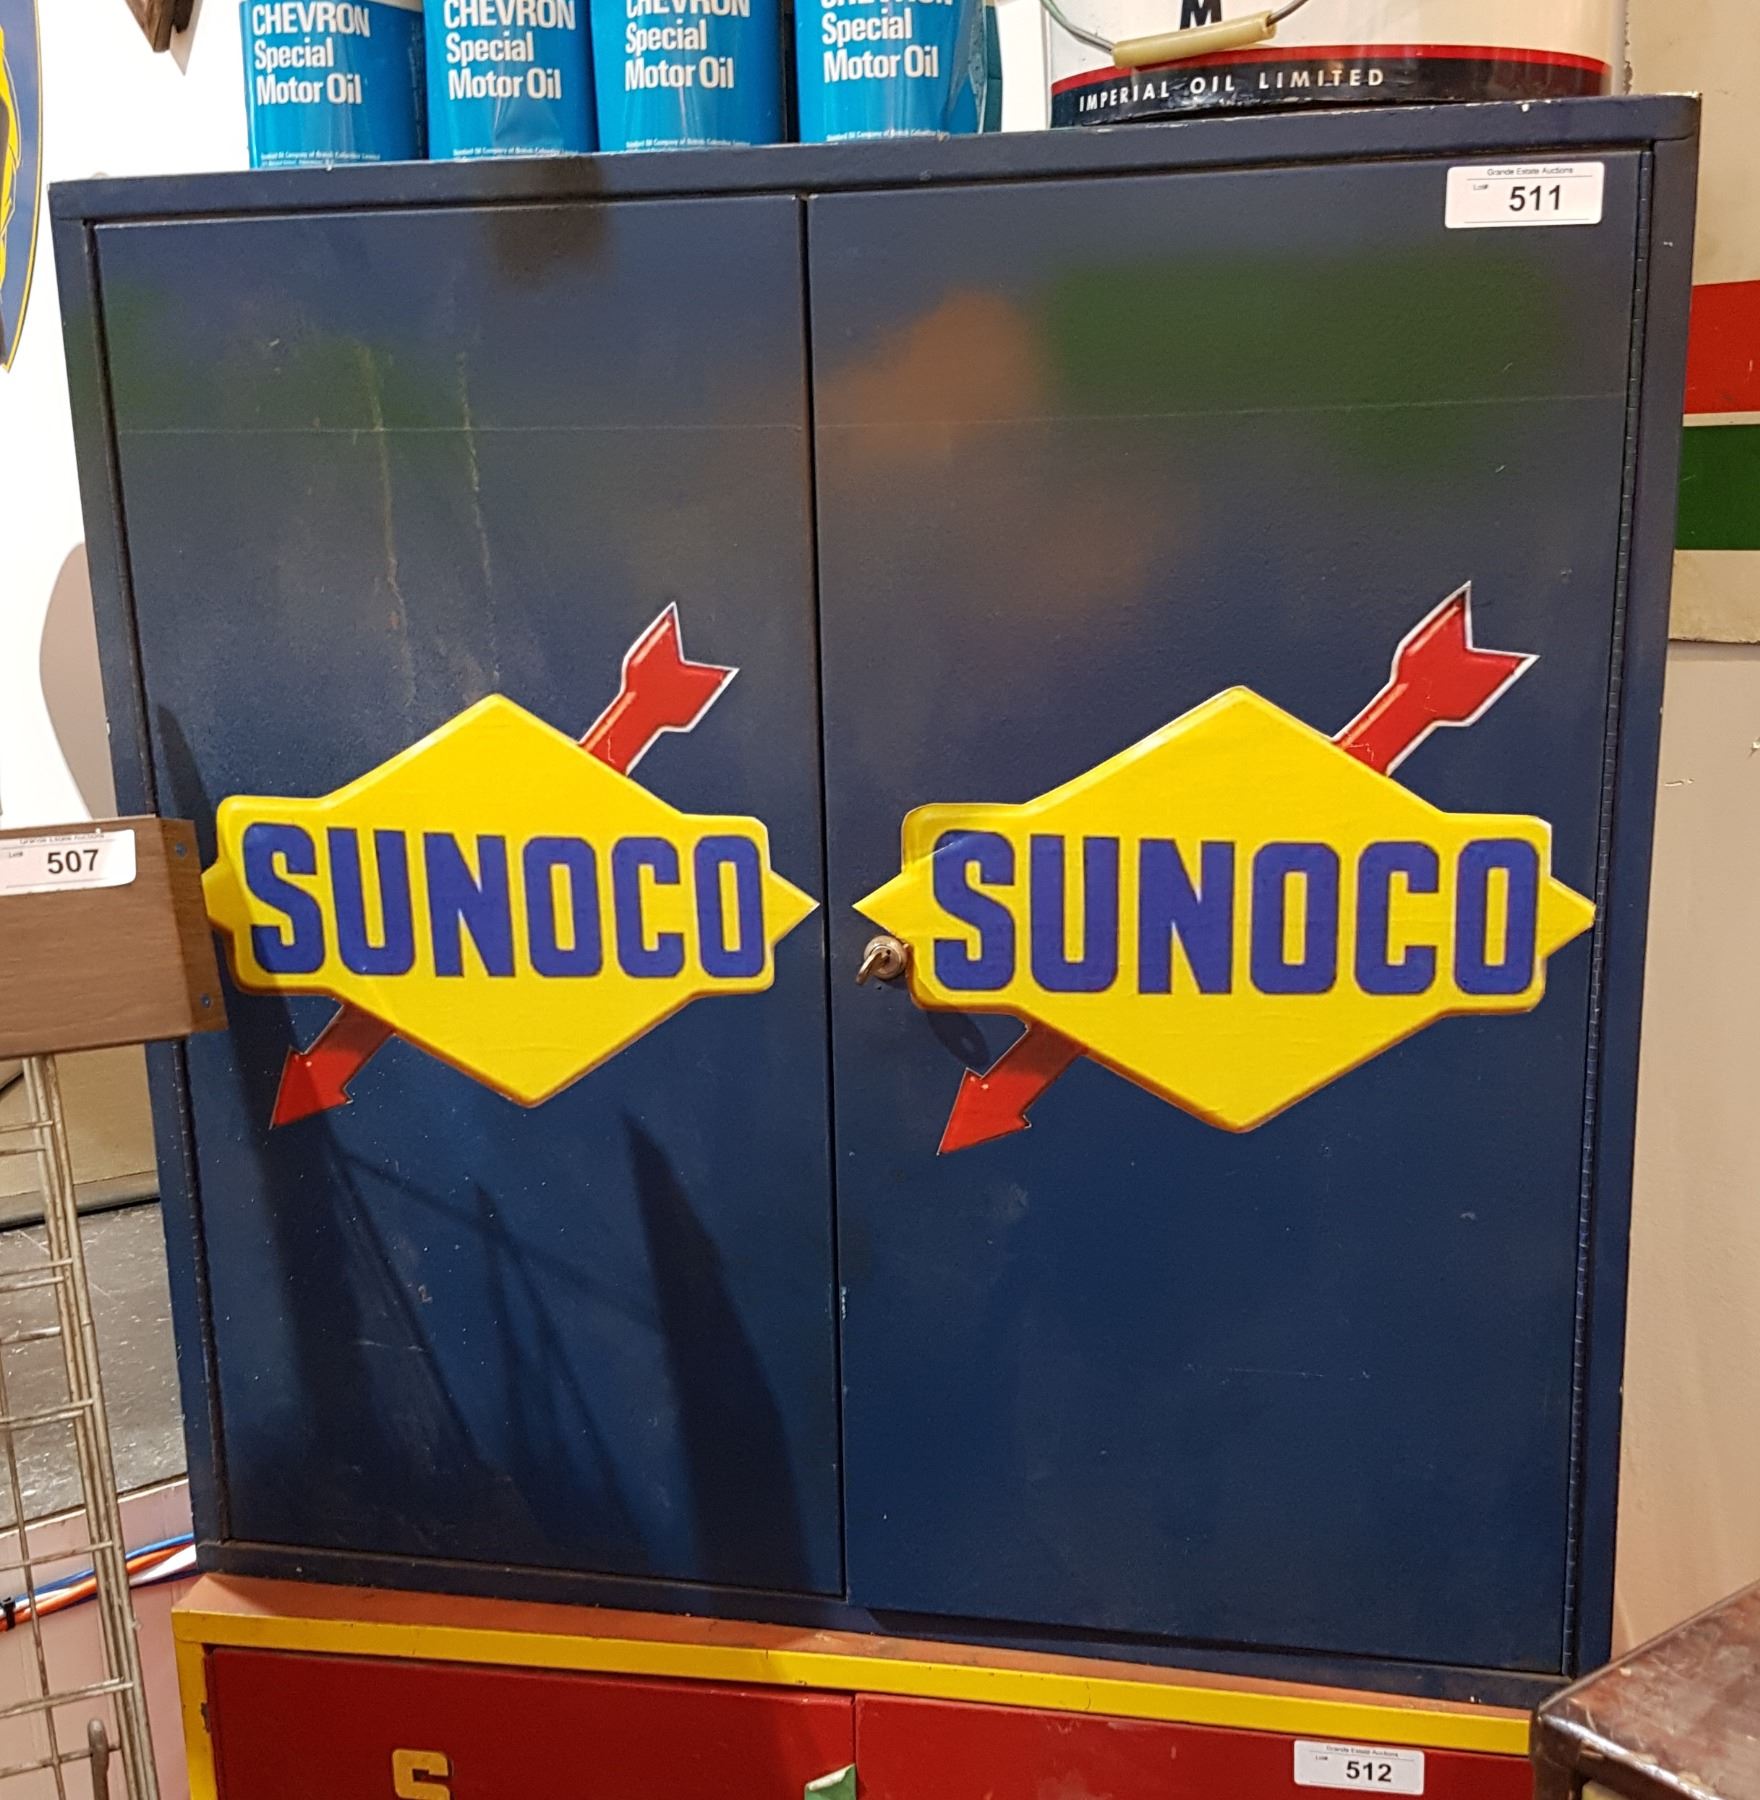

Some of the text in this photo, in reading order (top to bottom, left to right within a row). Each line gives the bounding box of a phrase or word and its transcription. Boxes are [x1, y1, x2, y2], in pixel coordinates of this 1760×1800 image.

[252, 1, 370, 37] CHEVRON
[443, 0, 576, 30] CHEVRON
[821, 8, 912, 47] Special
[446, 31, 534, 67] Special
[625, 19, 707, 56] Special
[254, 38, 333, 74] Special
[625, 56, 734, 91] Motor Oil
[823, 45, 939, 83] Motor Oil
[256, 74, 362, 105] Motor Oil
[449, 68, 561, 100] Motor Oil
[1079, 69, 1384, 112] IMPERIAL OIL LIMITED
[1487, 168, 1514, 176] Grande
[1509, 185, 1560, 212] 511
[47, 849, 98, 874] 507
[242, 822, 765, 978] SUNOCO
[932, 829, 1539, 995] SUNOCO
[1346, 1760, 1392, 1782] 512
